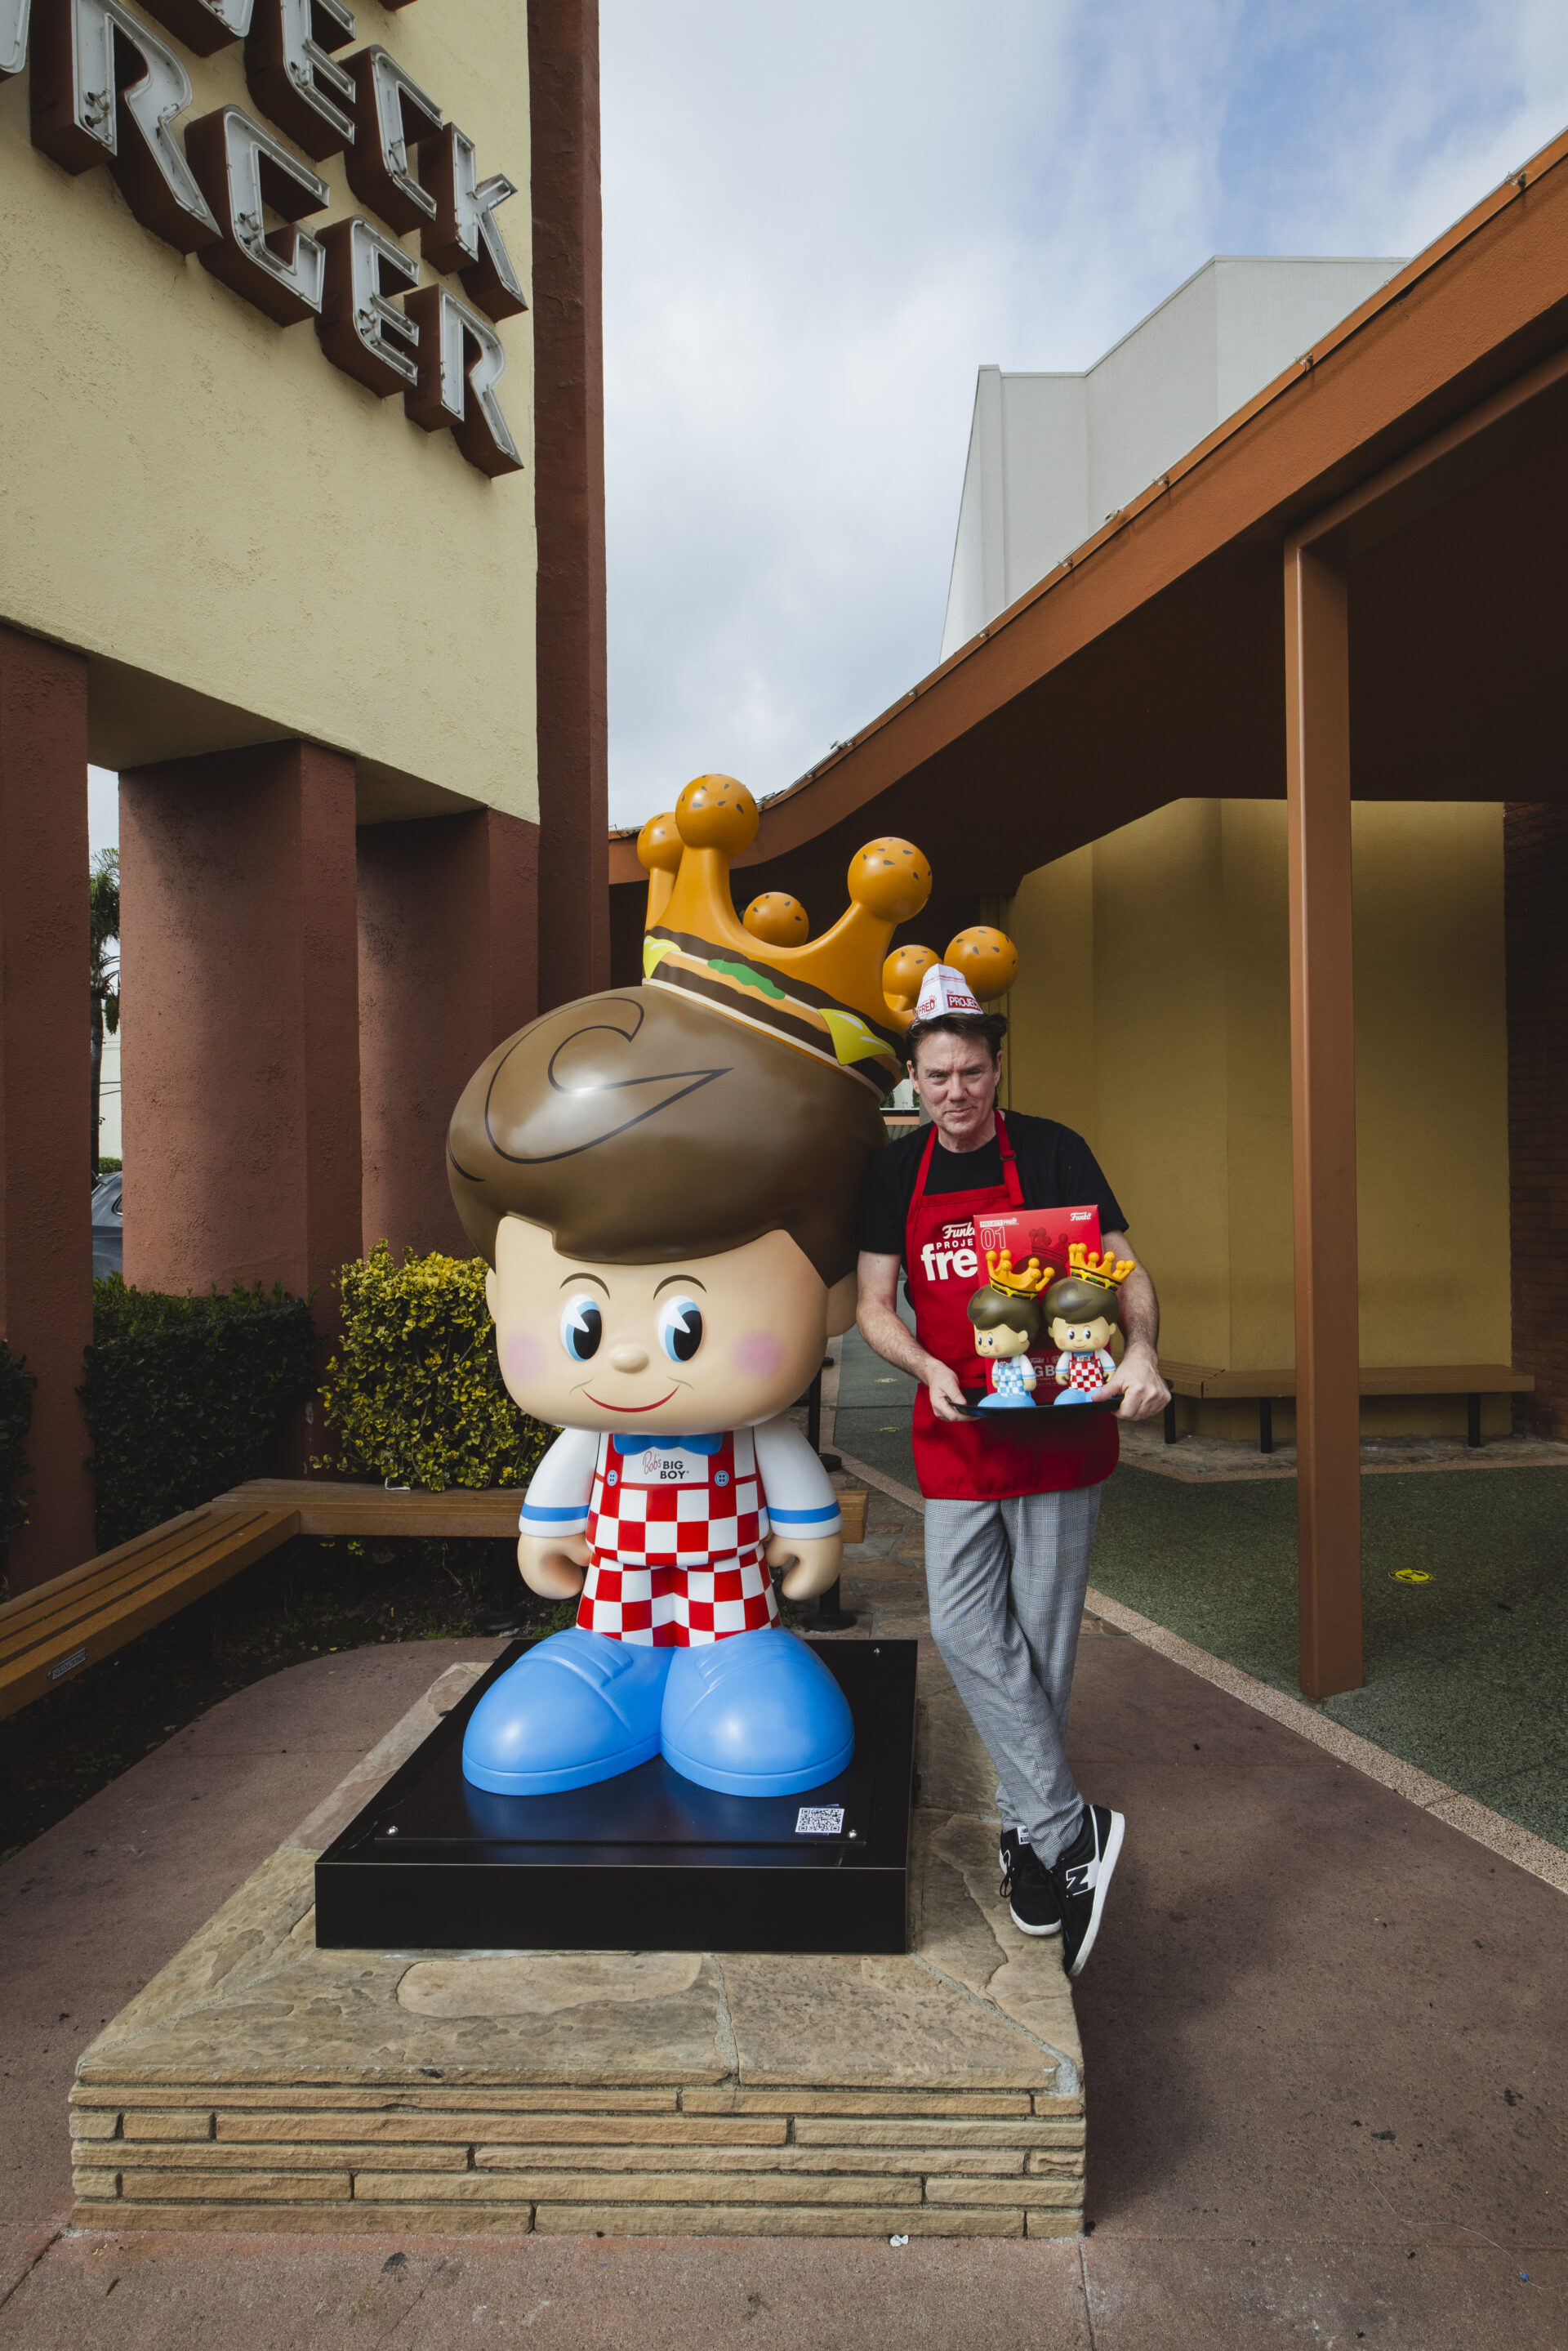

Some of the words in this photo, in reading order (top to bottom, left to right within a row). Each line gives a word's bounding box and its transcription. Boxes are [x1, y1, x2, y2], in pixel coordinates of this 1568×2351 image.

[194, 0, 529, 310] ECK
[1070, 1211, 1092, 1221] Funko
[942, 1221, 975, 1239] Funk
[981, 1226, 1006, 1251] 01
[936, 1238, 973, 1250] PROJE
[920, 1243, 978, 1282] fre
[643, 1450, 662, 1475] Bob's
[662, 1460, 684, 1470] BIG
